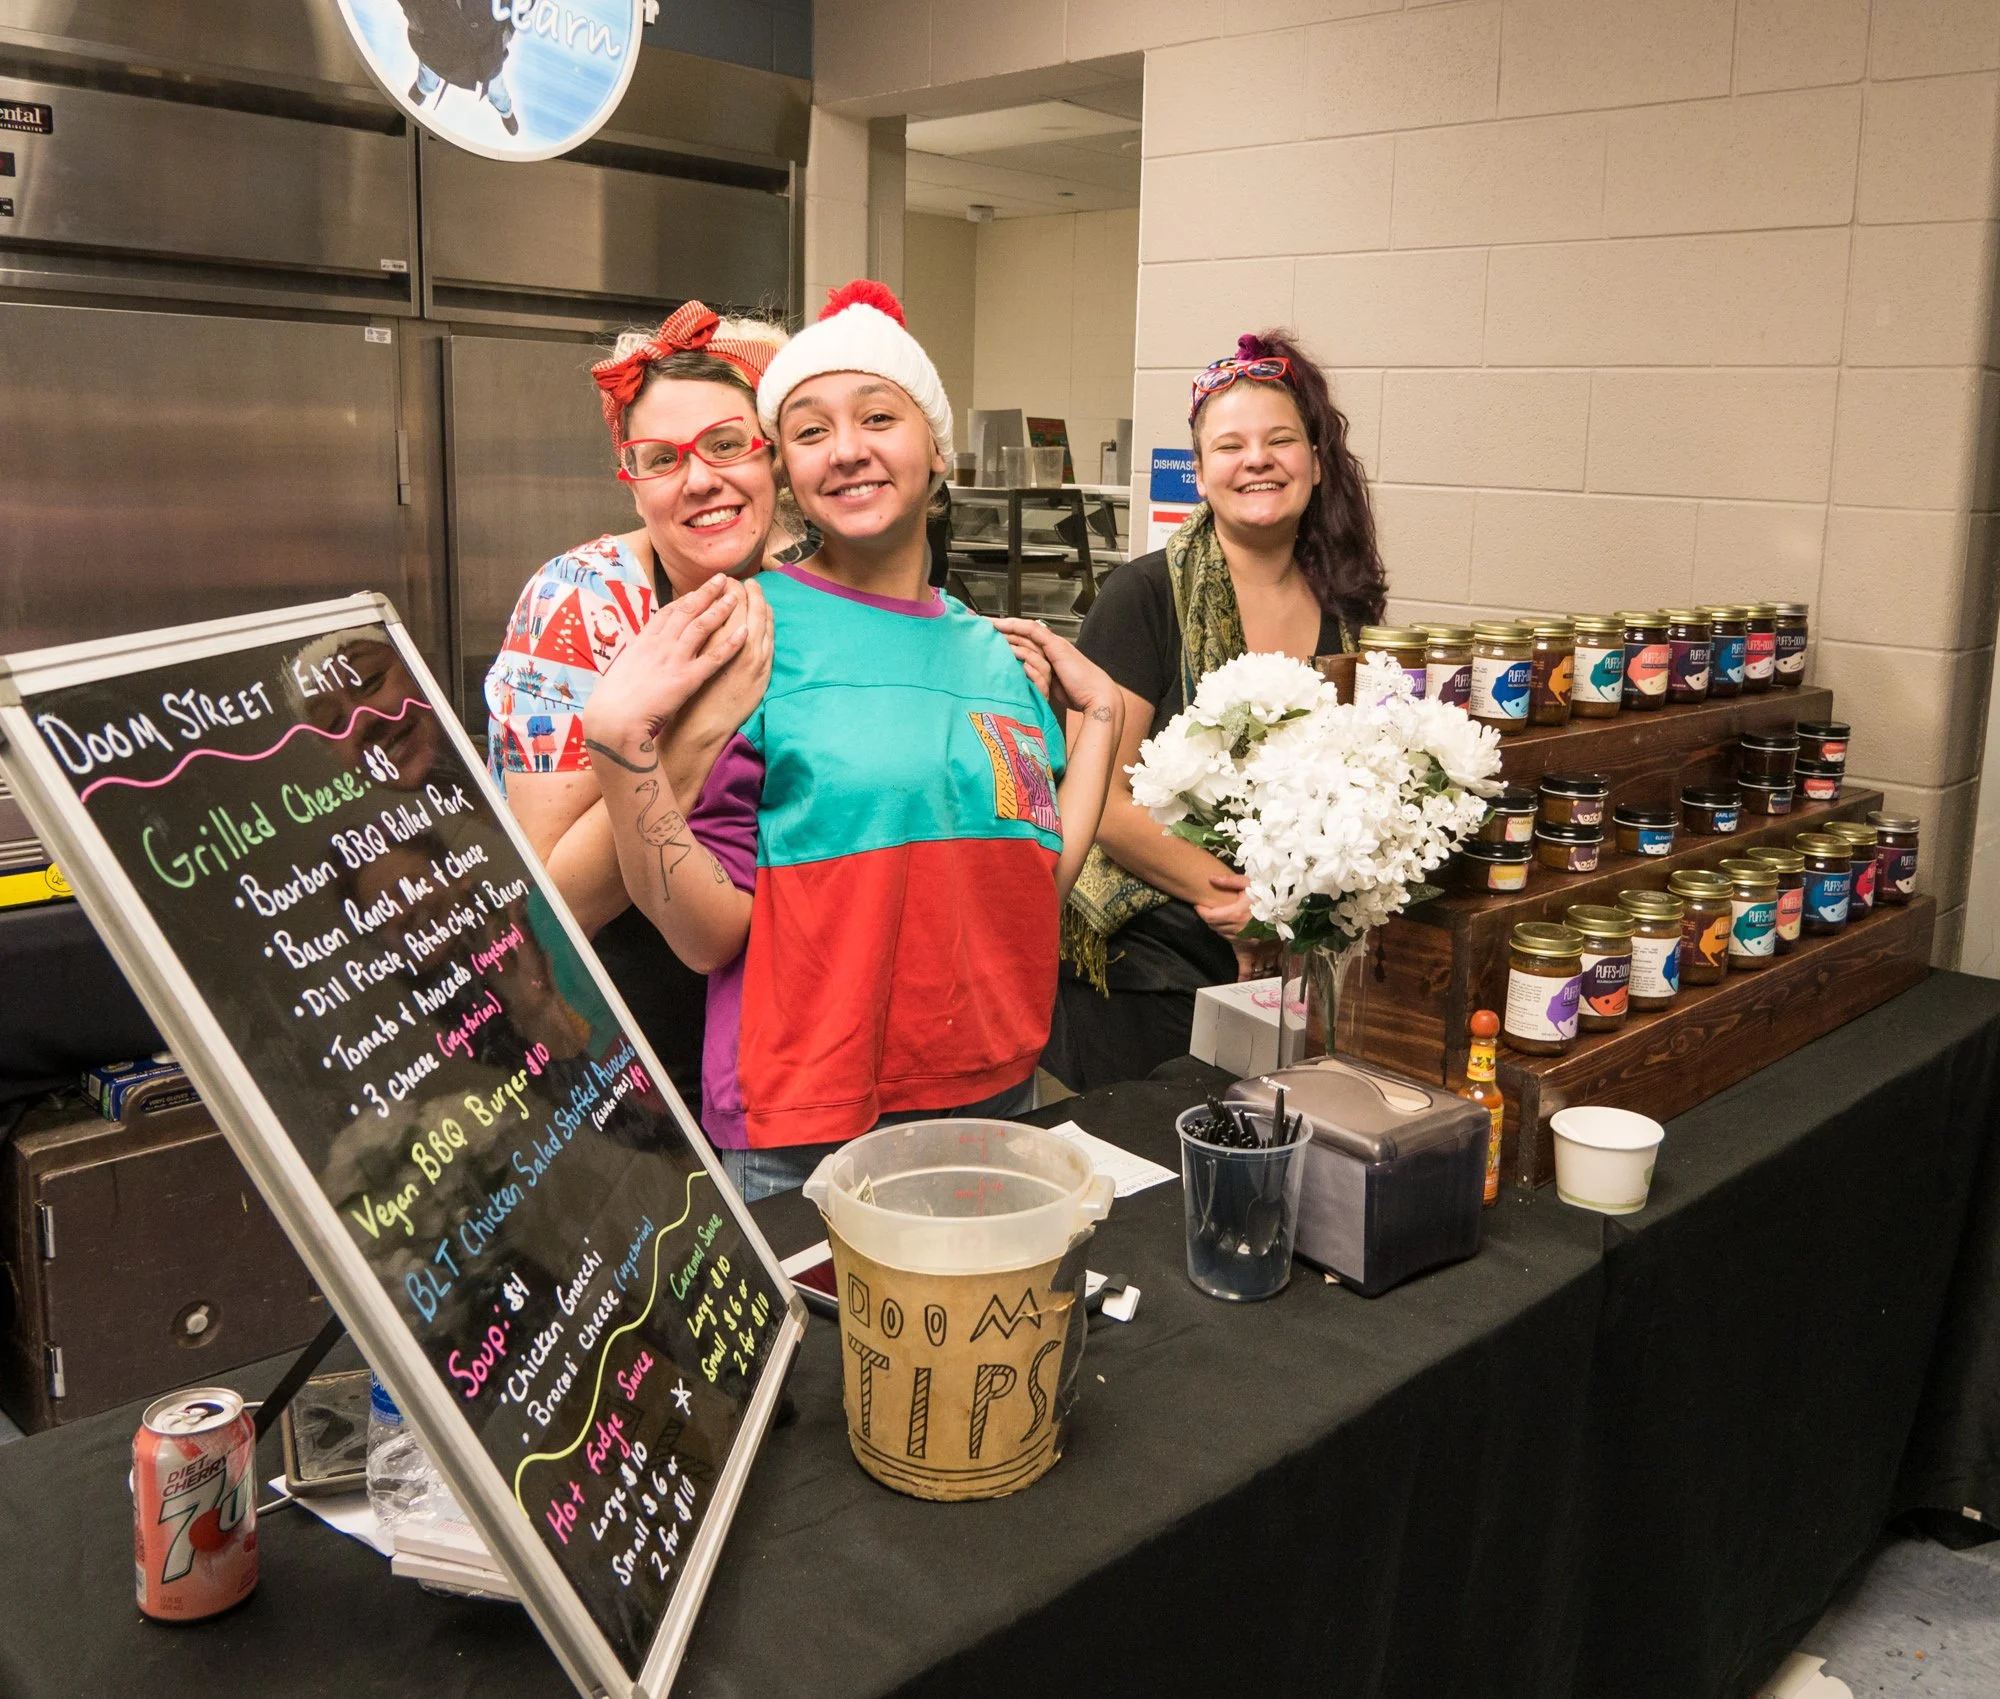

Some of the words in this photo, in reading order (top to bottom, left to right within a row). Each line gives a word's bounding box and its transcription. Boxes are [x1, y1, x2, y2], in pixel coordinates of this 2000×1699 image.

[37, 711, 173, 774] DOOM
[162, 681, 274, 740] STREET
[293, 654, 363, 698] EATS
[142, 801, 276, 889] Grilled
[281, 766, 371, 823] Cheese:
[363, 744, 400, 783] $8
[240, 861, 338, 917] Bourbon
[331, 823, 390, 869] BBQ
[380, 799, 433, 842] Pulled
[425, 784, 474, 816] Pork
[273, 927, 350, 969] Bacon
[343, 890, 404, 935] Ranch
[399, 876, 434, 905] Mac
[302, 976, 350, 1017] Dill
[481, 878, 530, 909] Bacon
[331, 1014, 400, 1072] Tomato
[412, 961, 473, 1016] Avocado
[362, 1082, 390, 1118] 3
[436, 990, 502, 1058] (vegetarian)
[628, 1064, 651, 1093] $9
[351, 1182, 421, 1239] Vegan
[411, 1117, 468, 1186] BBQ
[463, 1068, 530, 1127] Burger
[524, 1042, 550, 1076] $10
[404, 1238, 460, 1323] BLT
[459, 1183, 525, 1257] Chicken
[512, 1124, 564, 1187] Salad
[554, 1070, 600, 1141] Stuffed
[589, 1038, 636, 1088] Avocado
[613, 1215, 654, 1291] (vegetarian)
[669, 1243, 705, 1301] Caramel
[697, 1213, 723, 1248] Sauce
[448, 1304, 510, 1398] Soup:
[503, 1271, 530, 1312] $4
[507, 1320, 564, 1402] Chicken
[556, 1237, 602, 1316] Gnocchi
[687, 1293, 717, 1339] Large
[701, 1331, 727, 1383] Small
[738, 1278, 748, 1300] or
[738, 1327, 755, 1357] for
[751, 1291, 770, 1327] $10
[847, 1272, 1042, 1347] DOOM
[733, 1350, 748, 1376] 2
[847, 1331, 1062, 1460] TIPS
[162, 1449, 233, 1498] CHERRY
[166, 1453, 209, 1483] DIET
[546, 1480, 585, 1544] Hot
[617, 1351, 654, 1401] Sauce
[590, 1487, 627, 1541] Large
[612, 1517, 650, 1586] Small
[668, 1455, 678, 1475] or
[658, 1522, 680, 1556] for
[674, 1474, 696, 1521] $10
[651, 1551, 670, 1581] 2
